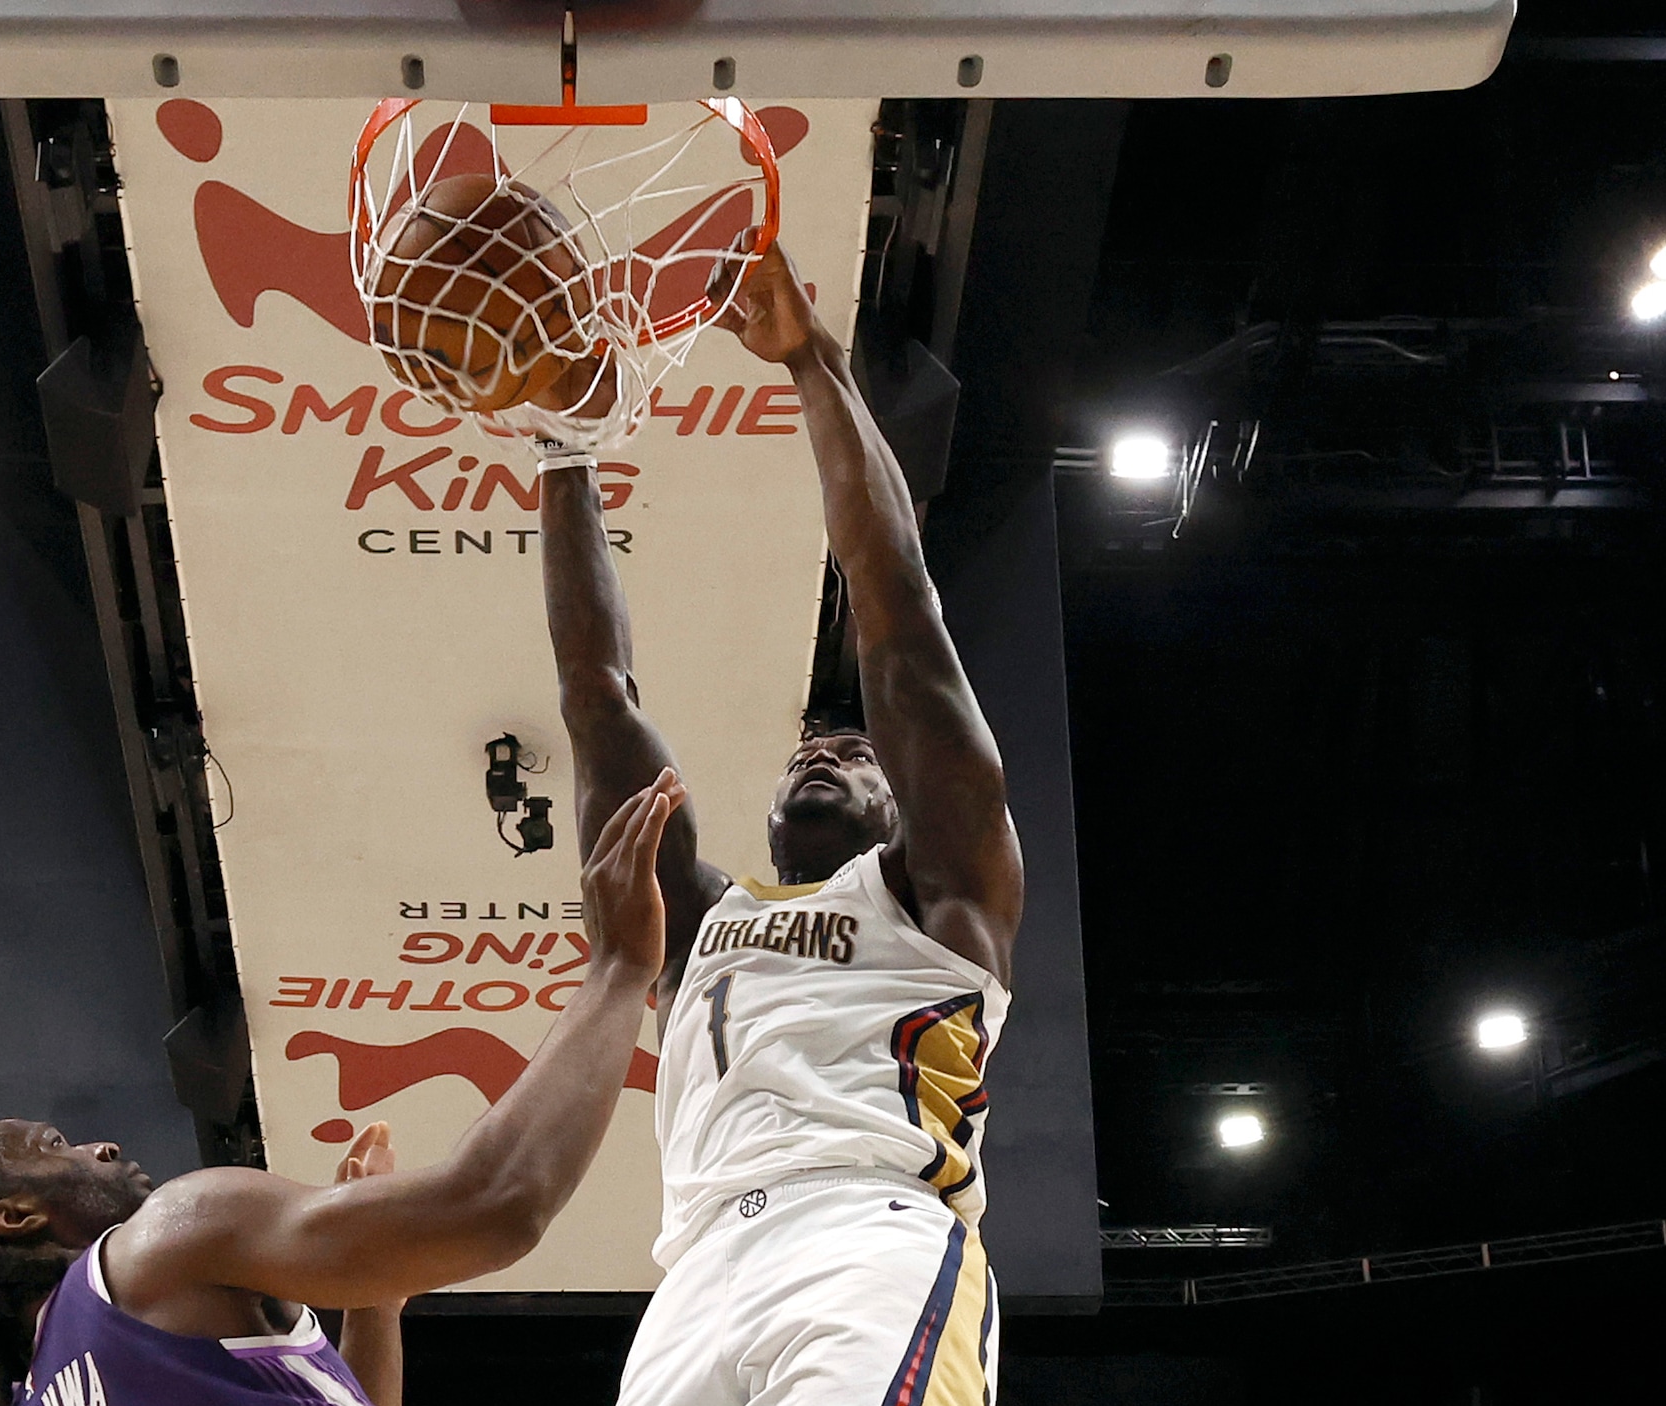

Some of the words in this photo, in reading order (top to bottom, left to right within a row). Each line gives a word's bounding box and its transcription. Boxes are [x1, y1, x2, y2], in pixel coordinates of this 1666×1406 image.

[189, 365, 803, 436] SMOHIE
[358, 529, 633, 554] CENTR
[399, 902, 584, 920] ENTER
[699, 911, 859, 965] ORLEANS
[702, 969, 737, 1084] 1
